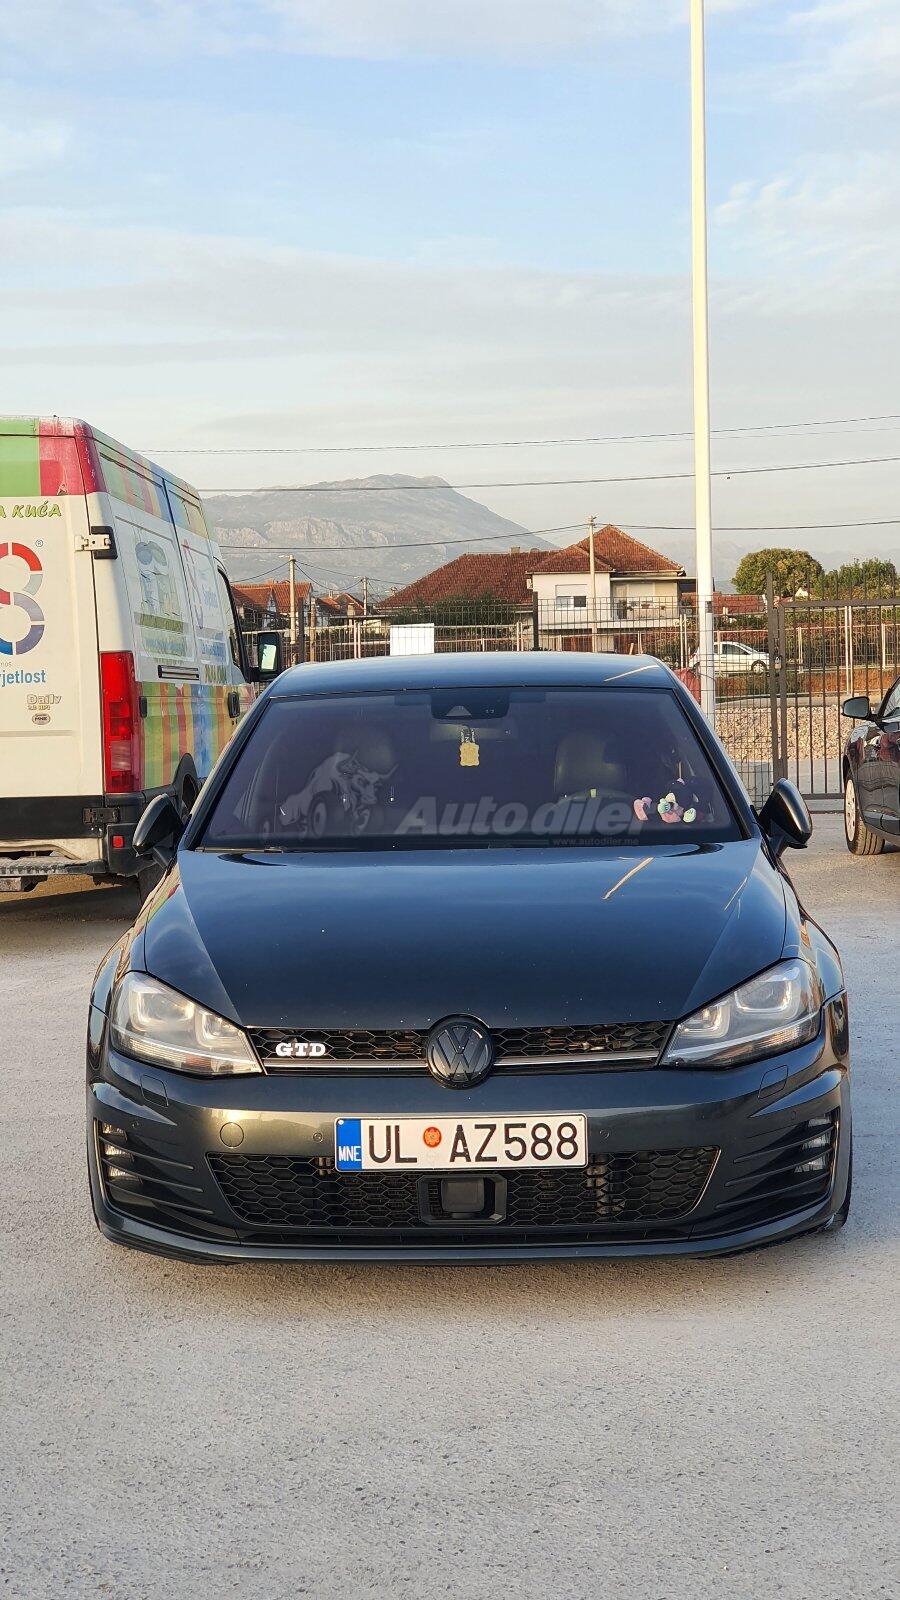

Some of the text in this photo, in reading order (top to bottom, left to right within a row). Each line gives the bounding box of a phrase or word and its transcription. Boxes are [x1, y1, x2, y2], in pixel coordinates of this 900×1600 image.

[0, 670, 46, 687] jetlost
[27, 694, 62, 704] Daily
[275, 1042, 326, 1057] GTD
[338, 1122, 579, 1163] MNE UL AZ588
